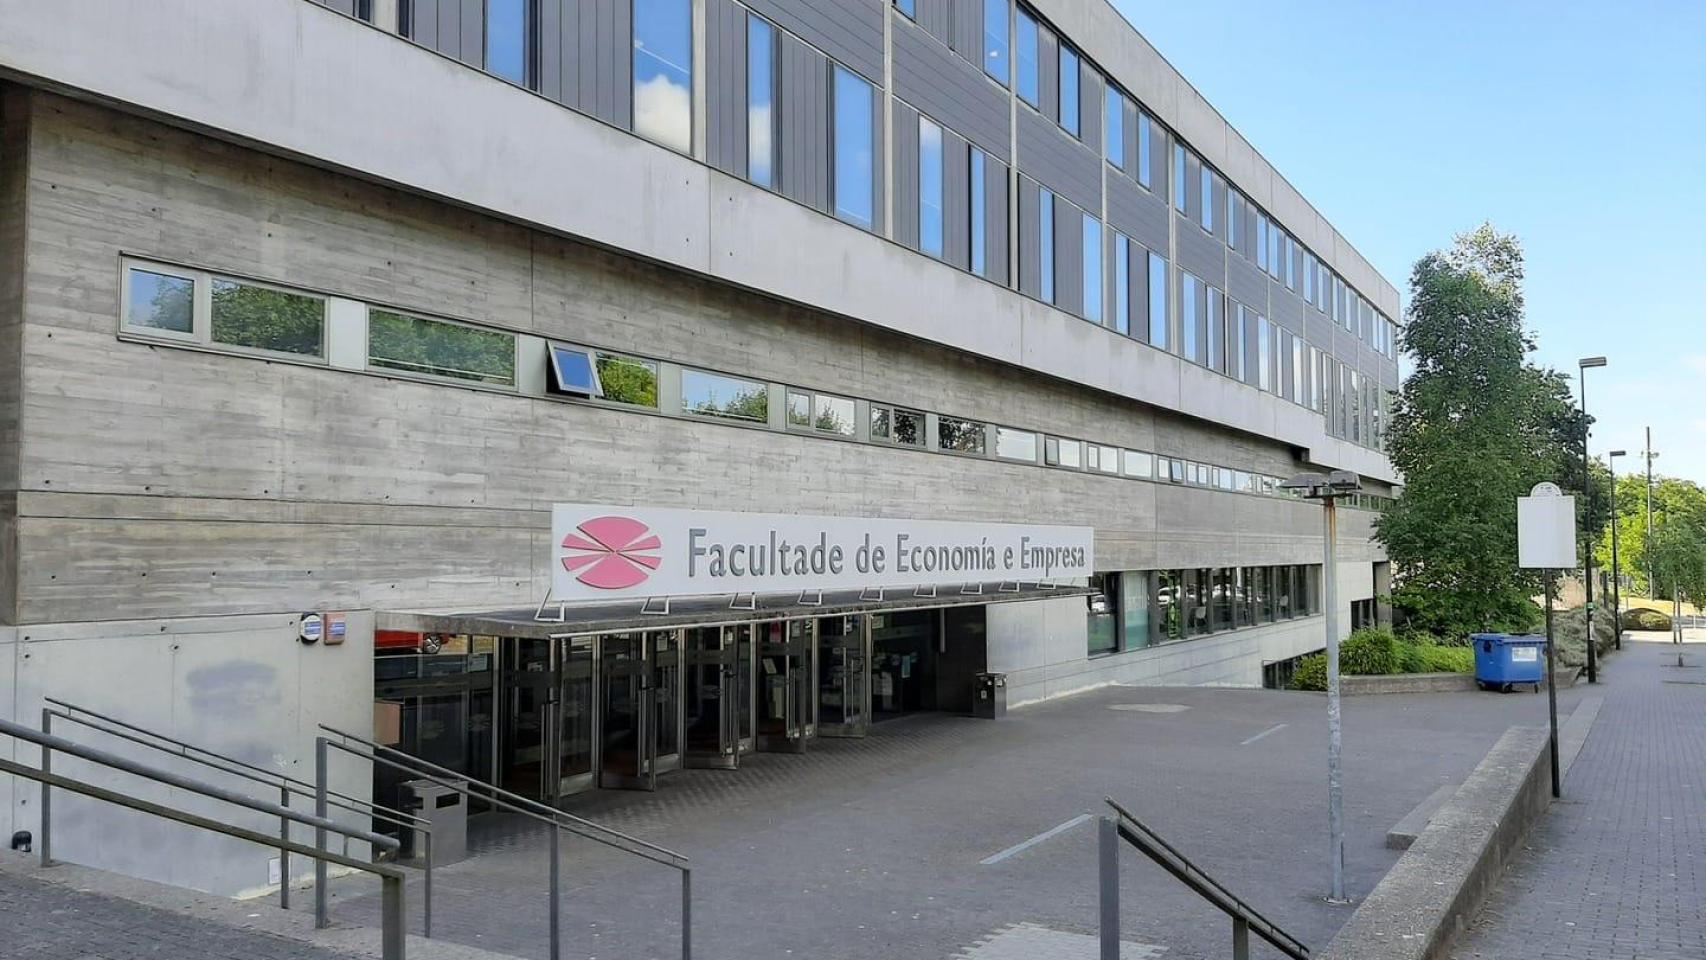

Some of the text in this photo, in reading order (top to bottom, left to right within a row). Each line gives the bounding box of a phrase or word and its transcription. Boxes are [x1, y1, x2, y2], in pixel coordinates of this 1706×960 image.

[689, 528, 1085, 578] Facultade de Economía e Empresa
